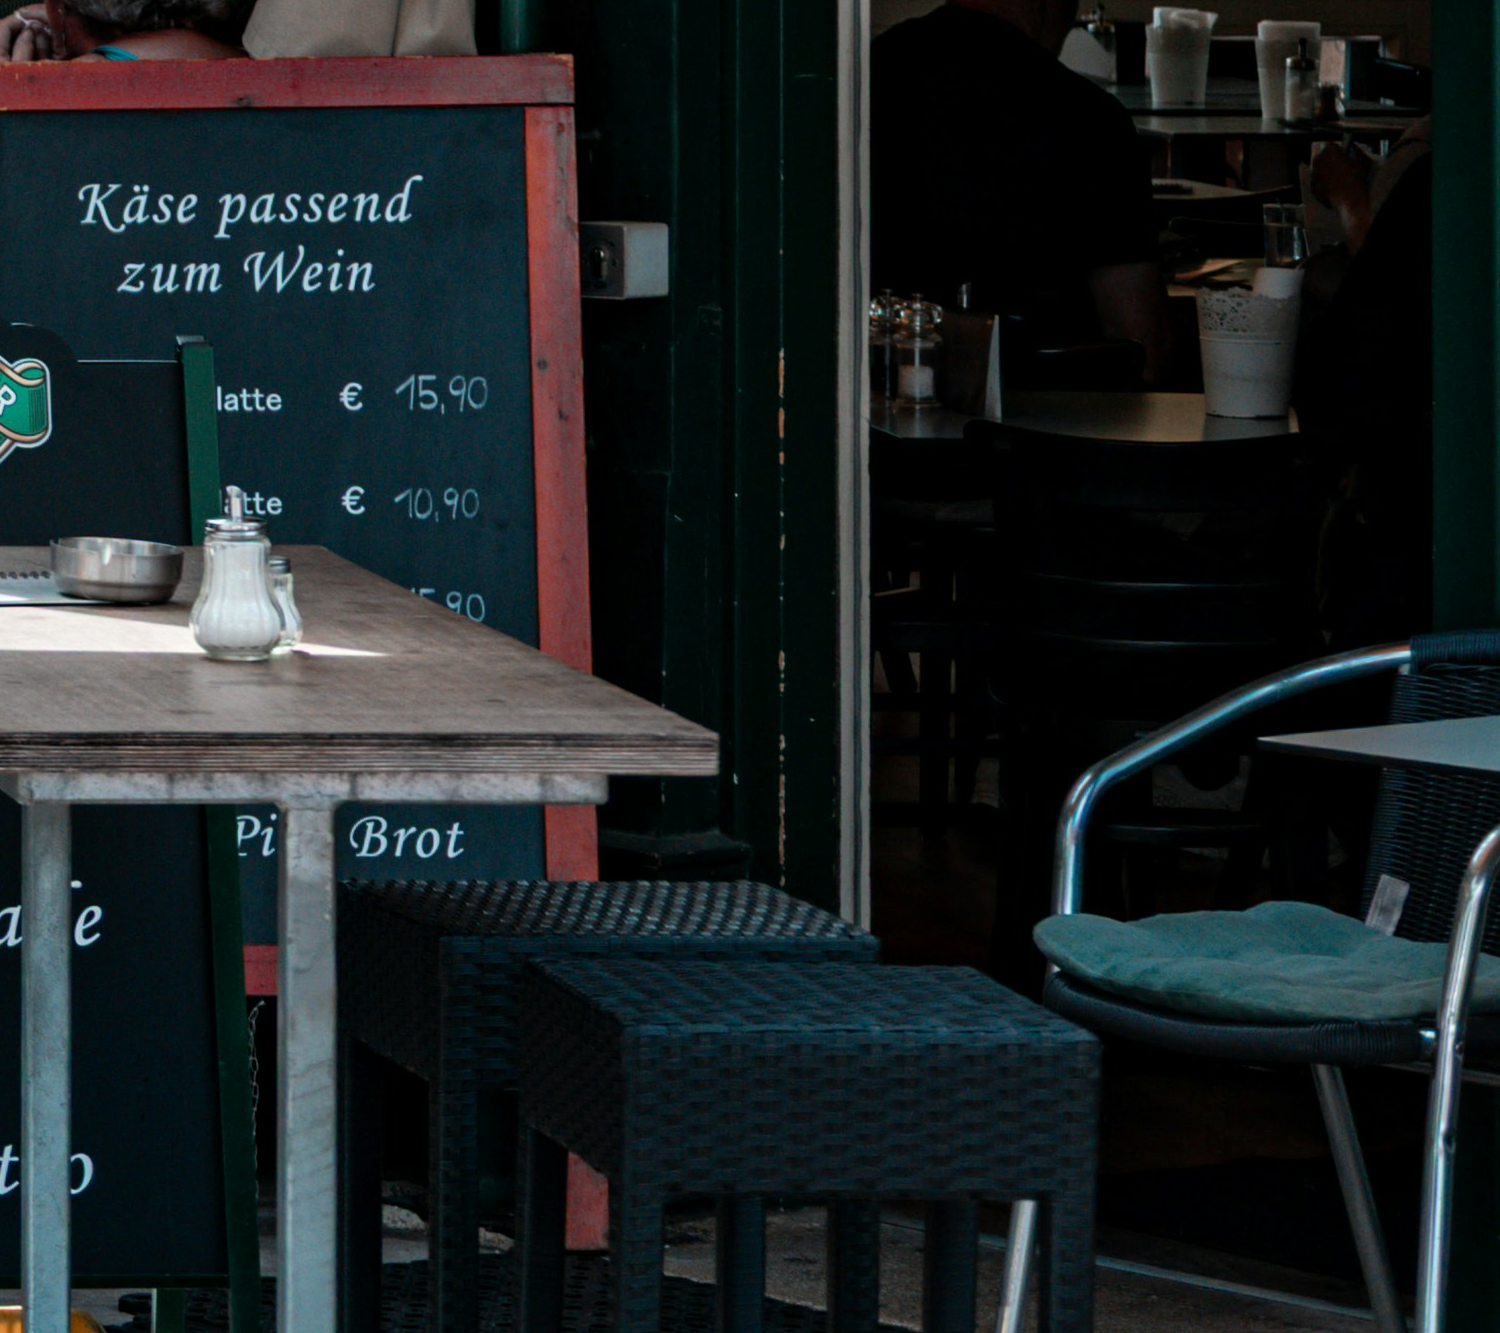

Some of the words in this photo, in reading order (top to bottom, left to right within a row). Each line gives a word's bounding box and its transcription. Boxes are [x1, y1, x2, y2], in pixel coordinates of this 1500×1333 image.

[78, 183, 198, 233] Käse
[214, 175, 423, 239] passend
[117, 261, 223, 293] zum
[243, 245, 376, 293] Wein
[339, 382, 364, 412] €
[395, 374, 489, 415] 15,90
[341, 486, 366, 516] €
[394, 487, 480, 523] 10,90
[349, 815, 465, 859] Brot
